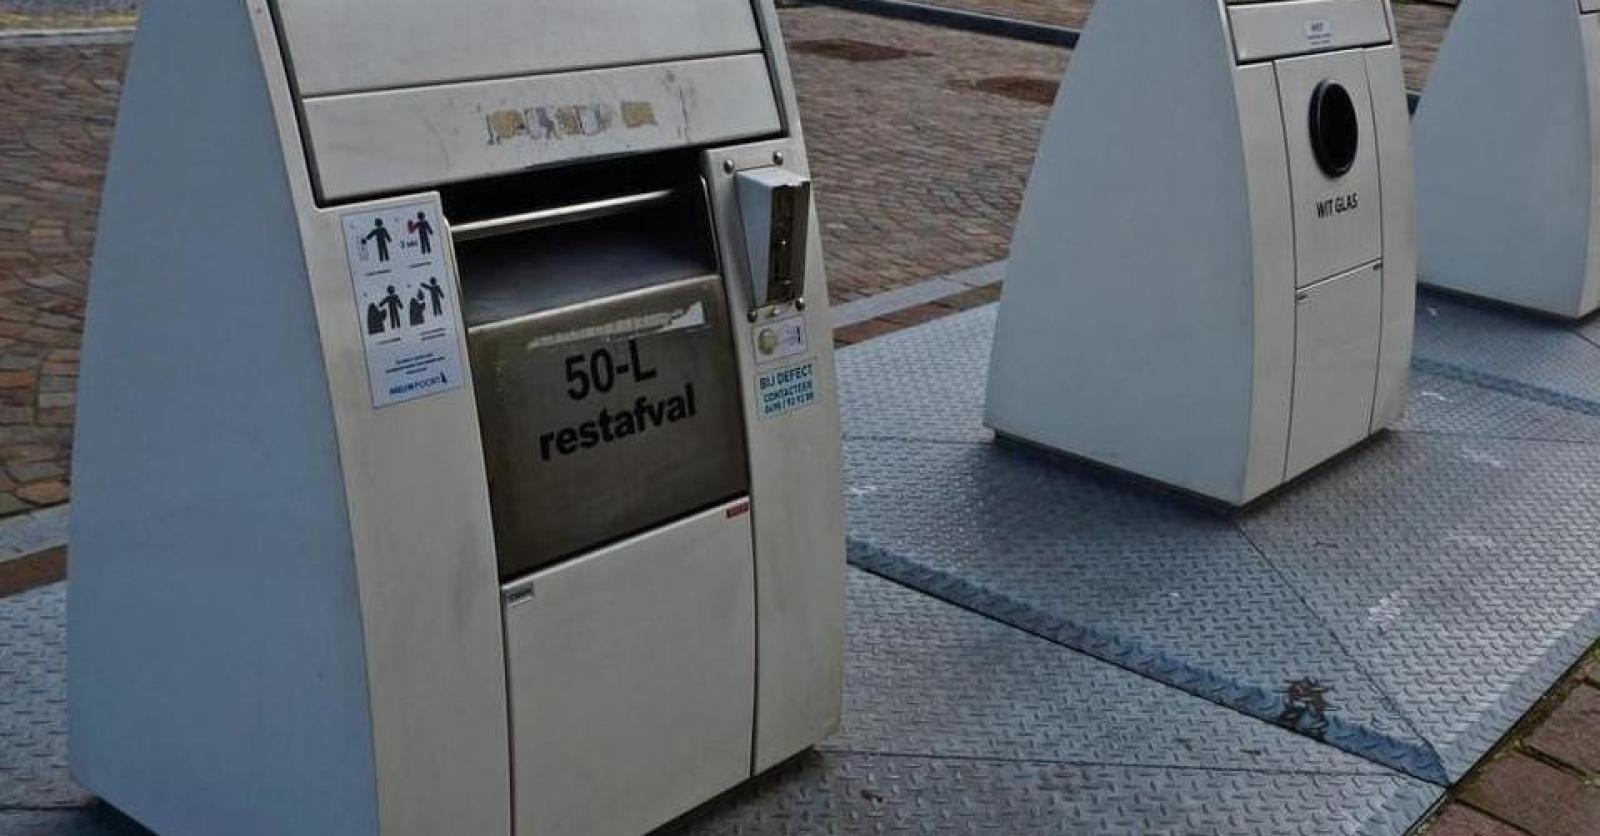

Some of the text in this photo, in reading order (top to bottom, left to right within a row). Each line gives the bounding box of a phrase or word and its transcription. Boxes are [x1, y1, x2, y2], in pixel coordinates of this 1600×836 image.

[1316, 192, 1358, 219] WIT GLAS
[564, 338, 657, 400] 50-L
[760, 363, 813, 390] BIJ DEFECT
[539, 381, 697, 463] restafval
